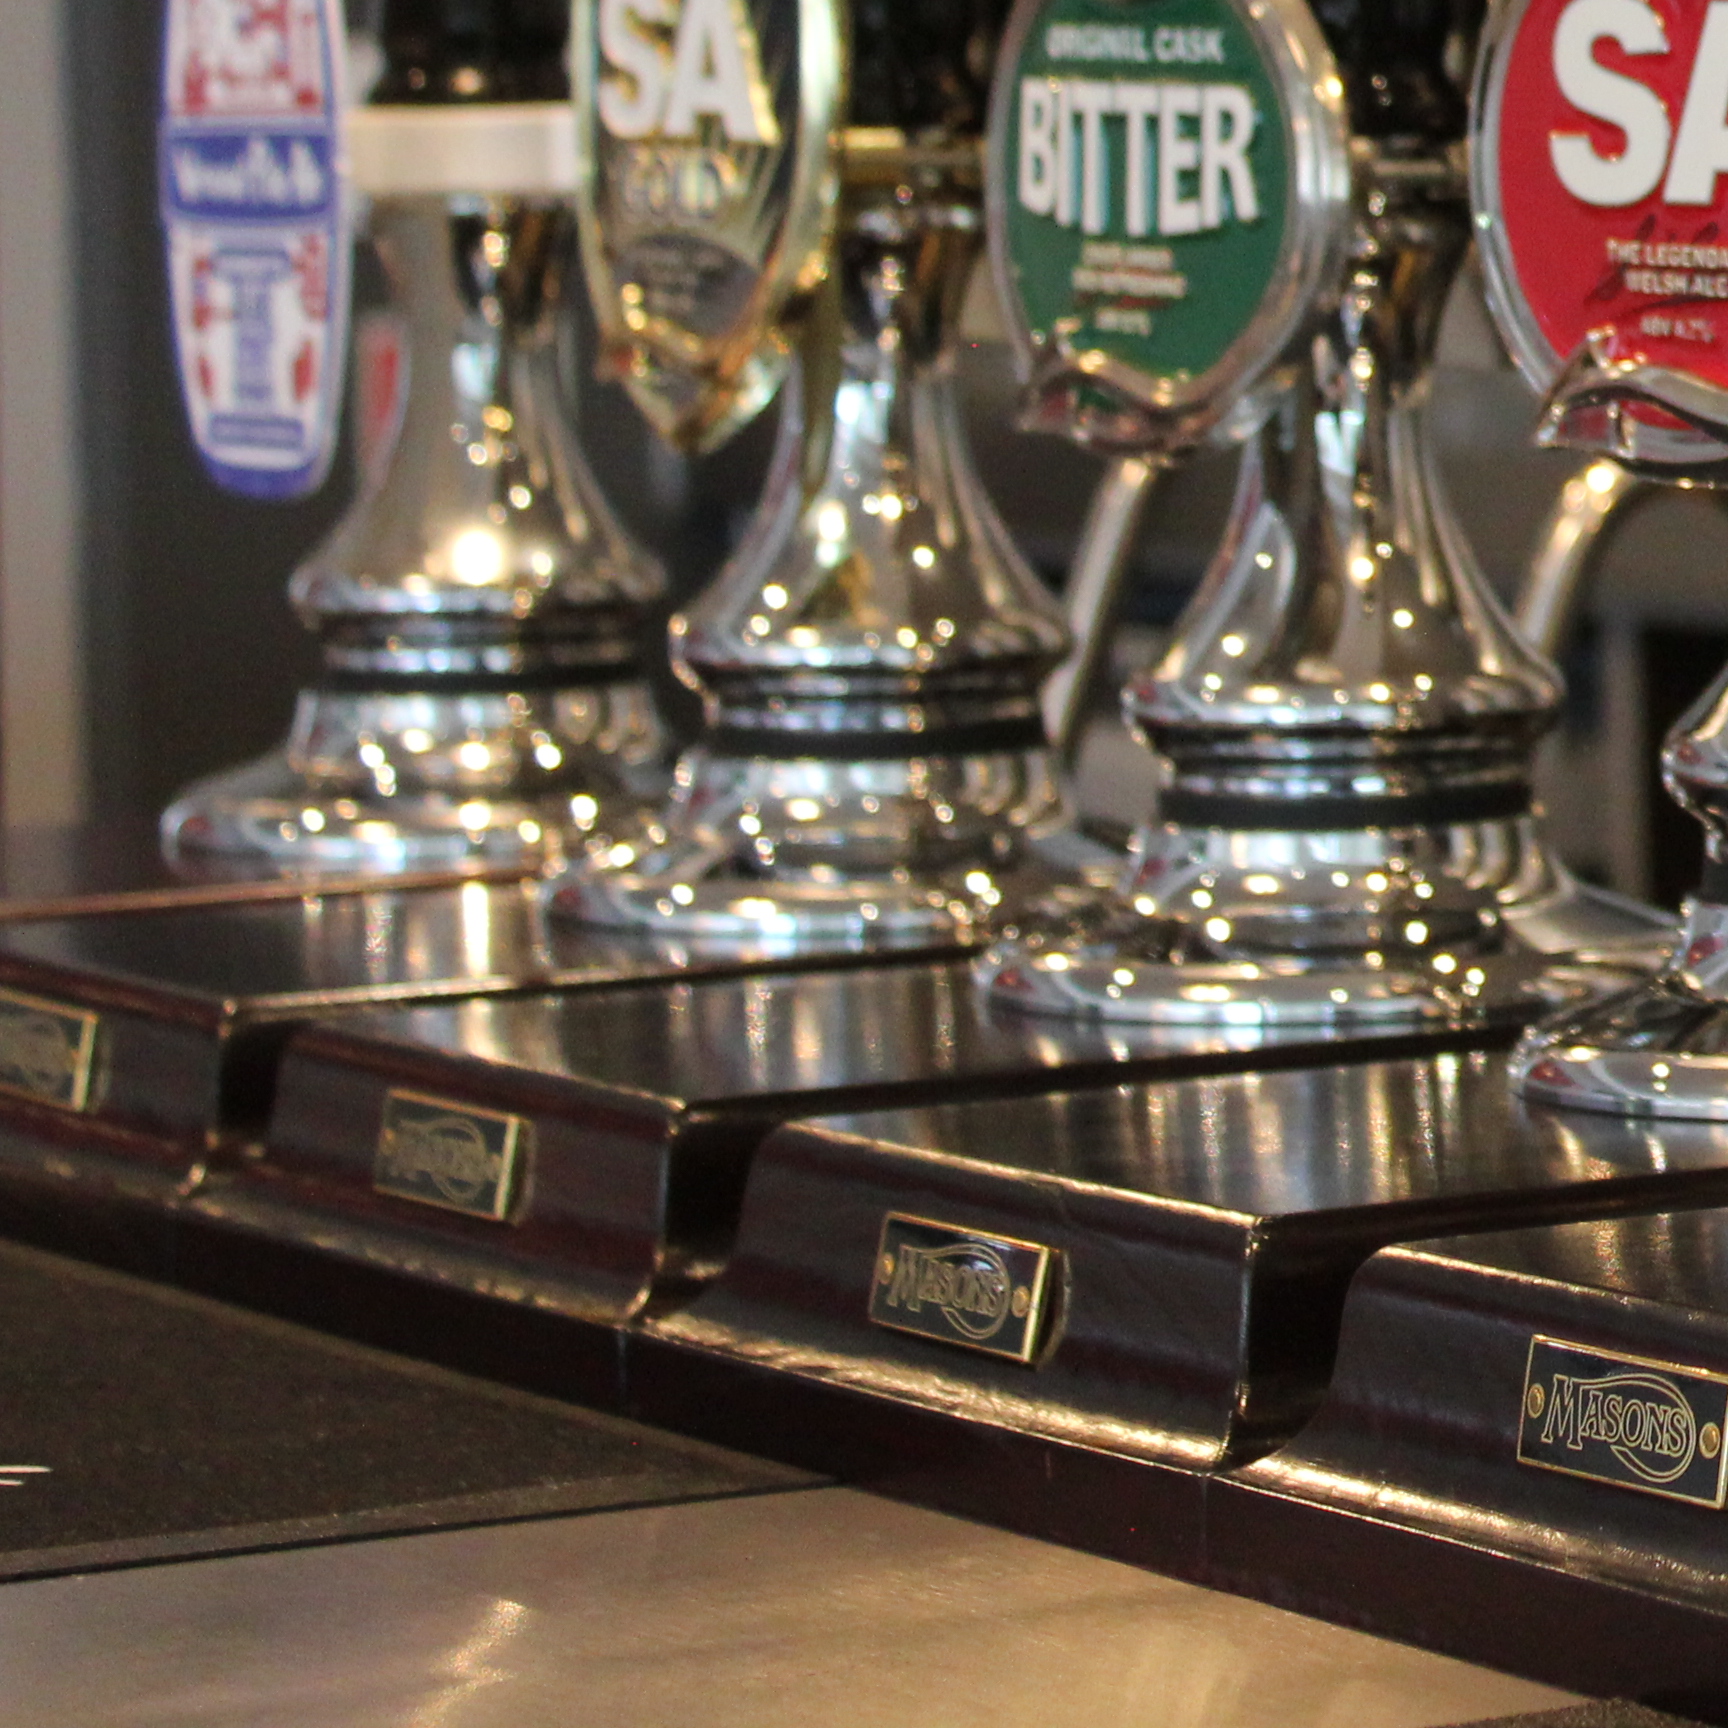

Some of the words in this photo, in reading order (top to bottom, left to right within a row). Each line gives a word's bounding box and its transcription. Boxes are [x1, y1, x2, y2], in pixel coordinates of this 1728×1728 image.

[1154, 26, 1224, 63] CASK
[1017, 76, 1258, 237] BITTER
[1624, 270, 1688, 296] WELSH
[1541, 1373, 1695, 1482] MASONS
